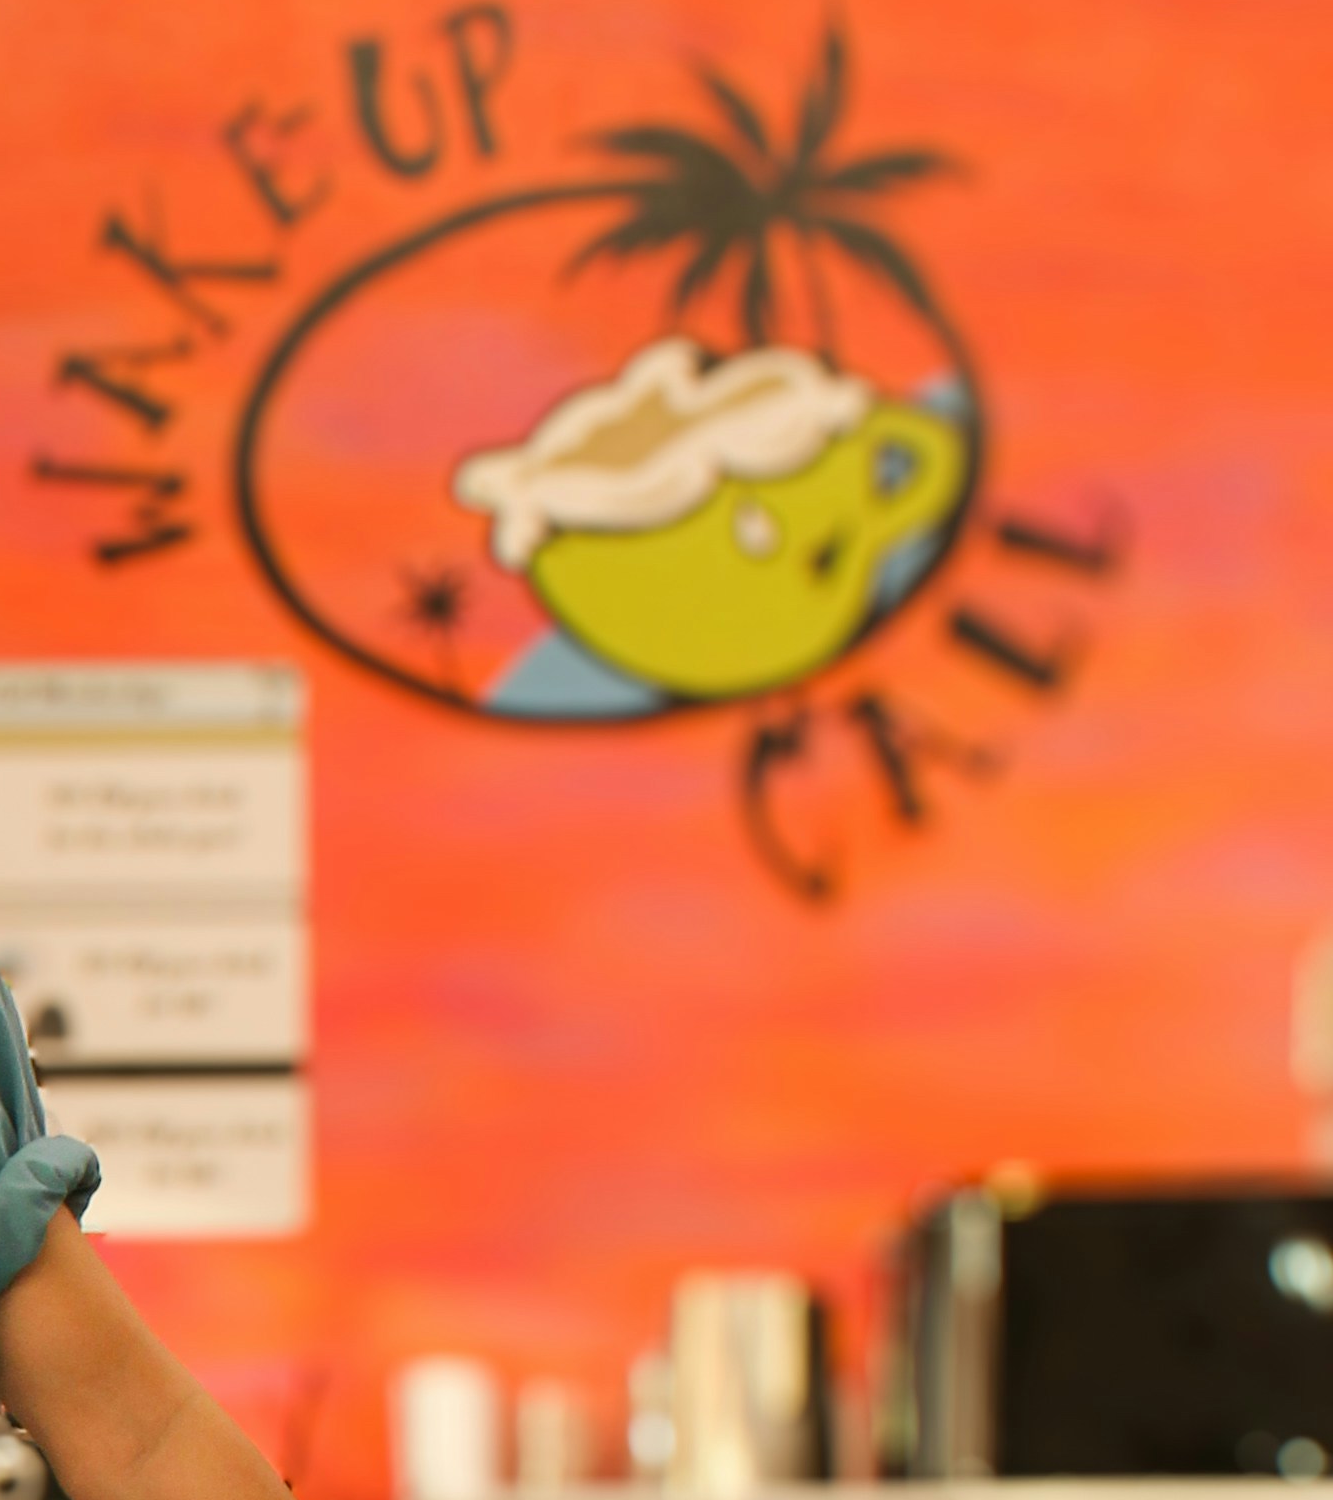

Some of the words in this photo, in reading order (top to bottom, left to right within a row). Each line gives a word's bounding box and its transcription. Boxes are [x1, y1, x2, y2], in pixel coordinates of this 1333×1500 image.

[27, 96, 331, 572] WAKE
[343, 0, 515, 184] UP
[741, 488, 1129, 905] CALL
